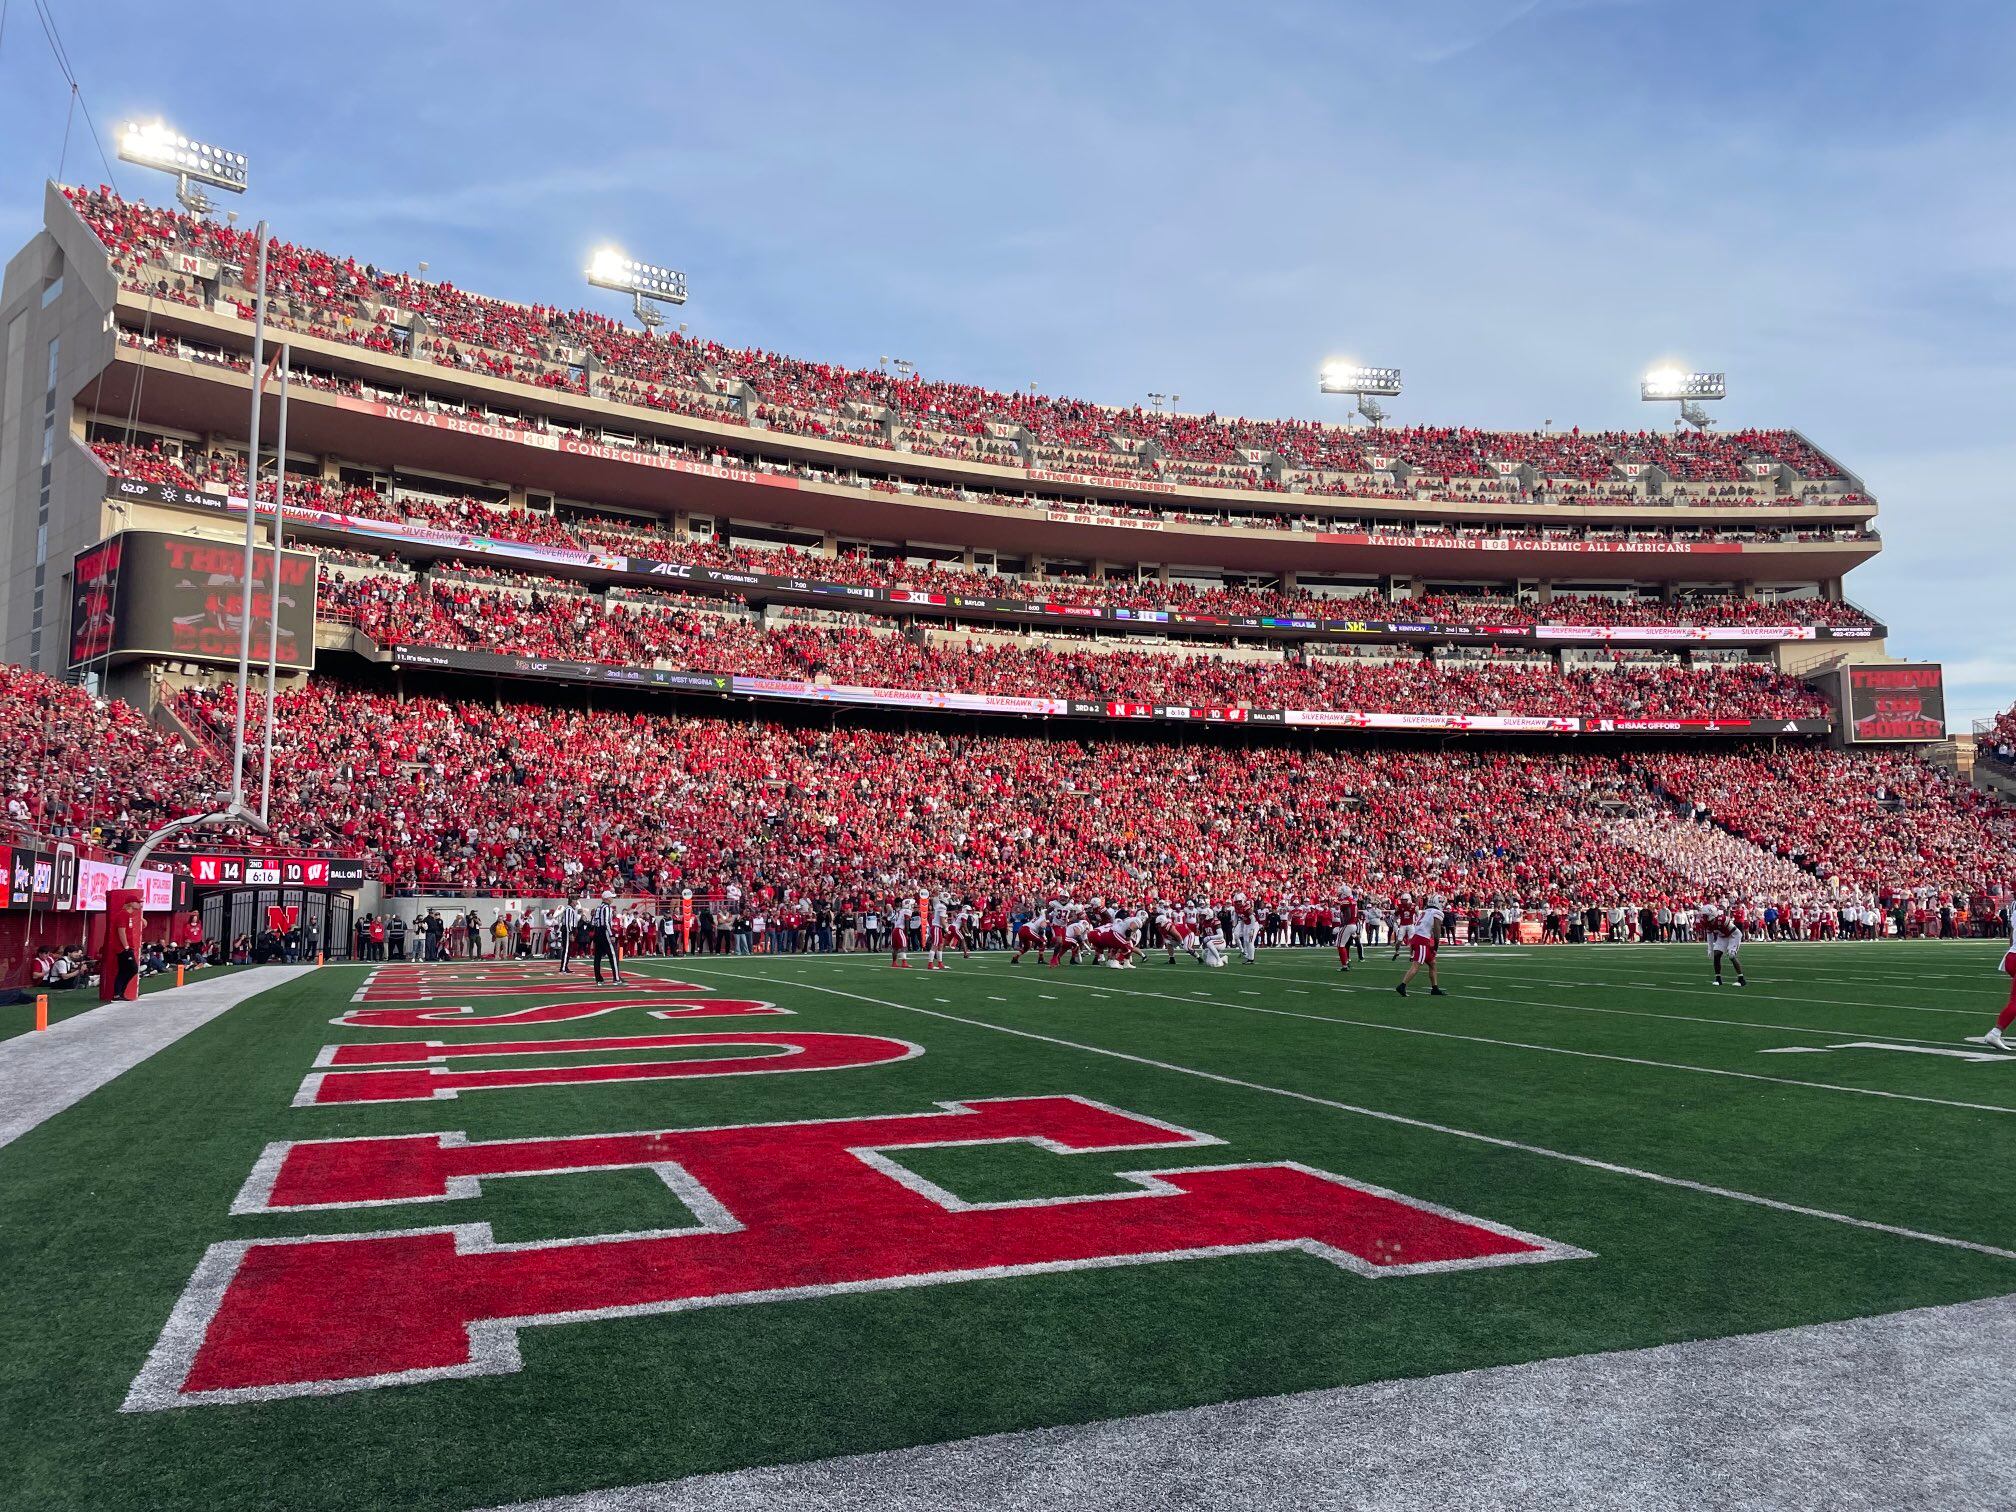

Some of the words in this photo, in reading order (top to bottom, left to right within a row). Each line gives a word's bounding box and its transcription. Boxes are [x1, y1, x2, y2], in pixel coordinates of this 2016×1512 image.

[183, 257, 198, 273] N
[997, 426, 1007, 437] N
[386, 405, 438, 427] NCAA
[448, 419, 515, 442] RECORD
[525, 434, 557, 449] 403
[566, 441, 676, 470] CONSECUTIVE
[686, 461, 756, 483] SELLOUTS
[1250, 451, 1260, 461] N
[1375, 459, 1385, 468] N
[1501, 463, 1510, 473] N
[1628, 466, 1638, 475] N
[1758, 465, 1768, 474] N
[1027, 470, 1085, 484] NATIONAL
[1090, 475, 1176, 493] CHAMPIONSHIPS
[121, 482, 148, 496] 62.0°
[184, 493, 201, 505] 5.4
[203, 496, 221, 508] MPH
[1074, 514, 1091, 523] 1971
[1142, 520, 1160, 530] 1997
[401, 526, 460, 542] SILVERHAWK
[1367, 535, 1416, 547] NATION
[1422, 538, 1476, 549] LEADING
[1515, 541, 1582, 551] ACADEMIC
[1588, 542, 1611, 552] ALL
[1616, 543, 1692, 553] AMERICANS
[534, 547, 588, 561] SILVERHAWK
[650, 563, 693, 578] ACC
[722, 573, 744, 582] VIRGINIA
[744, 576, 758, 584] TECH
[847, 588, 863, 596] DUKE
[964, 599, 985, 607] BAYLOR
[1065, 608, 1091, 616] HOUSTON
[531, 663, 547, 671] UCF
[671, 676, 688, 684] WEST
[688, 677, 712, 686] VIRGINIA
[754, 681, 806, 692] SILVERHAWK
[873, 689, 922, 700] SILVERHAWK
[985, 697, 1033, 707] SILVERHAWK
[1114, 704, 1126, 716] N
[1135, 706, 1145, 715] 14
[1171, 709, 1186, 717] 6:16
[1210, 710, 1220, 719] 10
[1301, 713, 1345, 721] SILVERHAWK
[1402, 716, 1445, 724] SILVERHAWK
[1600, 720, 1614, 731] N
[1647, 722, 1680, 730] GIFFORD
[268, 860, 274, 868] 11
[200, 861, 215, 880] N
[224, 863, 239, 878] 14
[287, 864, 301, 880] 10
[307, 864, 322, 881] W
[331, 870, 347, 878] BALL
[252, 871, 274, 882] 6:16
[510, 901, 516, 910] 1
[267, 905, 299, 936] N
